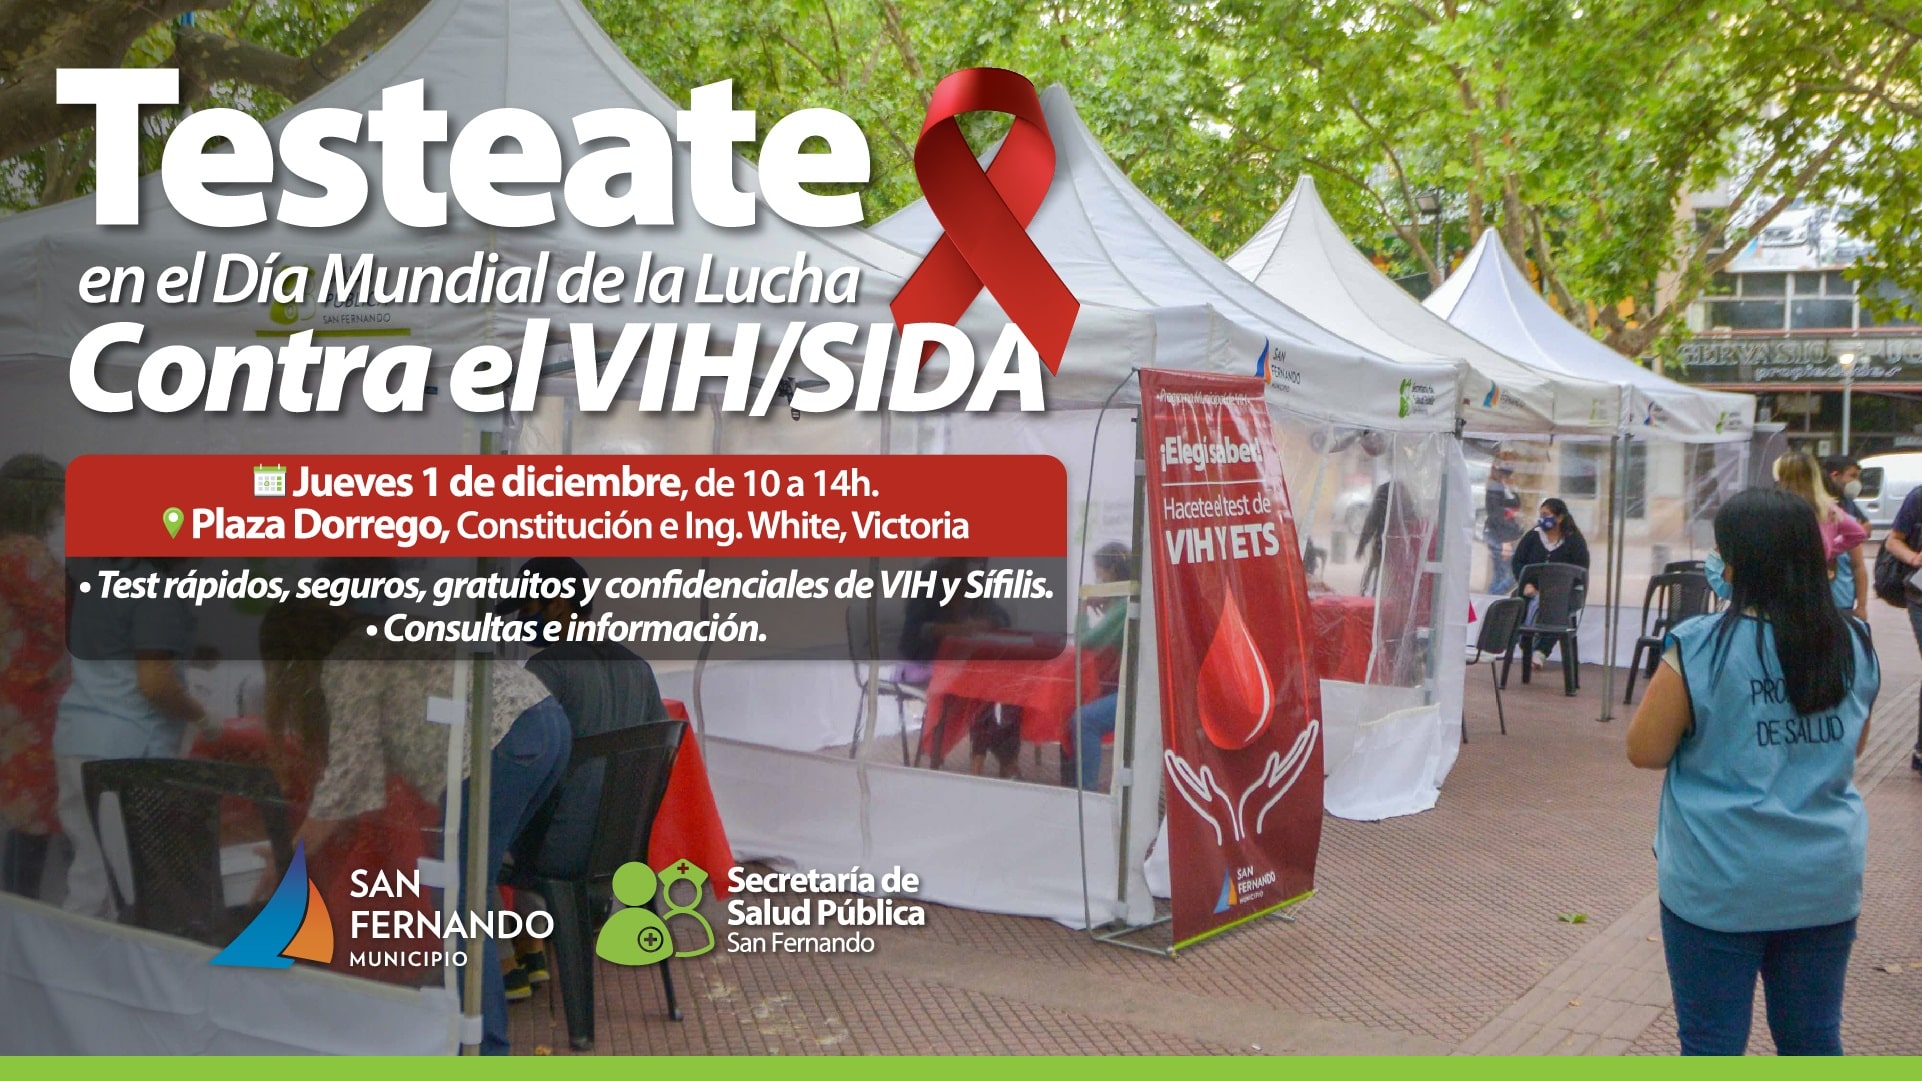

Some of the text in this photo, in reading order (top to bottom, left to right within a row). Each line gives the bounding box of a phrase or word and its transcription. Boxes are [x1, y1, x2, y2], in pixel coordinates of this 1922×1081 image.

[1163, 491, 1272, 520] Hacete el test de
[1165, 521, 1280, 566] VIH Y ETS
[1757, 715, 1845, 747] DE SALUD
[1237, 865, 1254, 881] SAN
[1238, 871, 1276, 894] FERNANDO
